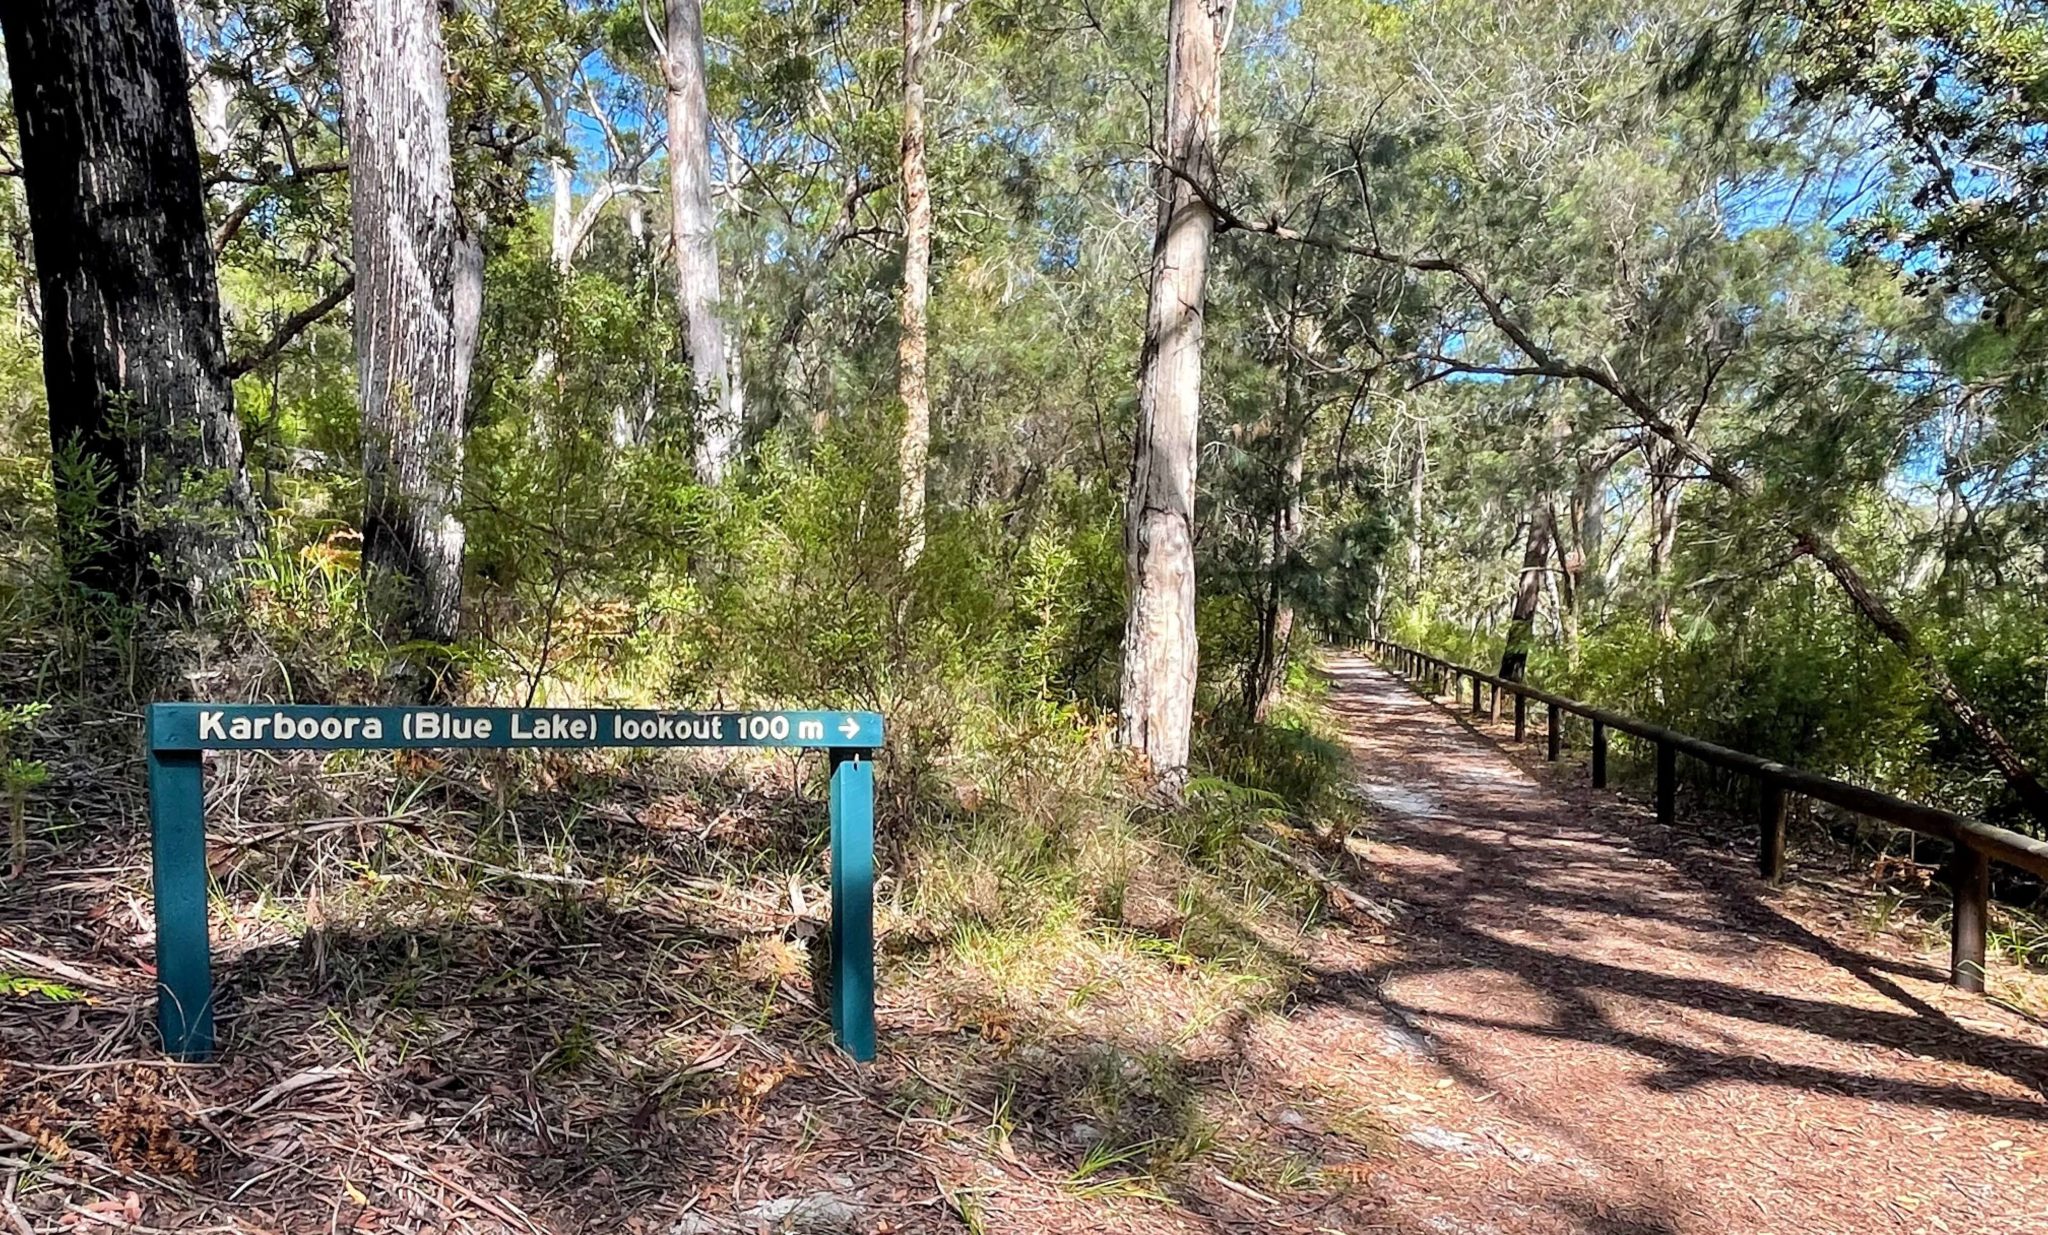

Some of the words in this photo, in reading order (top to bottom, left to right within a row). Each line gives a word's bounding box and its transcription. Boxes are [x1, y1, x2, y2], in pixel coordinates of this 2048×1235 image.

[199, 711, 383, 740] Karboora
[402, 712, 493, 740] (Blue
[511, 713, 598, 740] Lake)
[614, 714, 723, 741] lookout
[738, 715, 790, 741] 100
[798, 719, 825, 741] m
